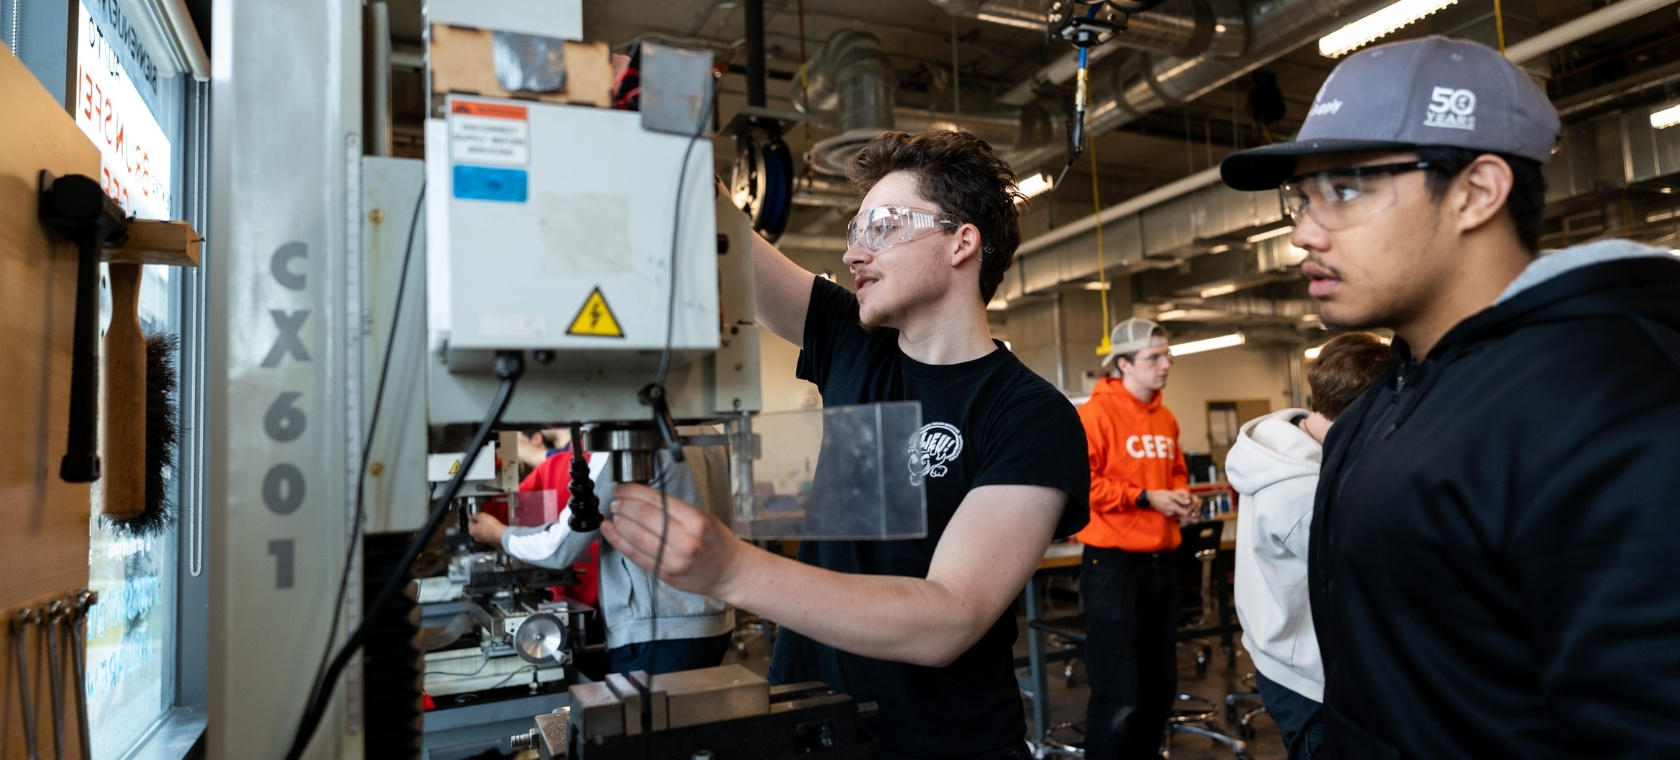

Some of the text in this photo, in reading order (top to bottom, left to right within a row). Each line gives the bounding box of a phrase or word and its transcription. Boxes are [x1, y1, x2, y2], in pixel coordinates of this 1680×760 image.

[1428, 86, 1476, 115] 50
[1426, 109, 1476, 126] YEARS
[261, 241, 312, 590] CX601
